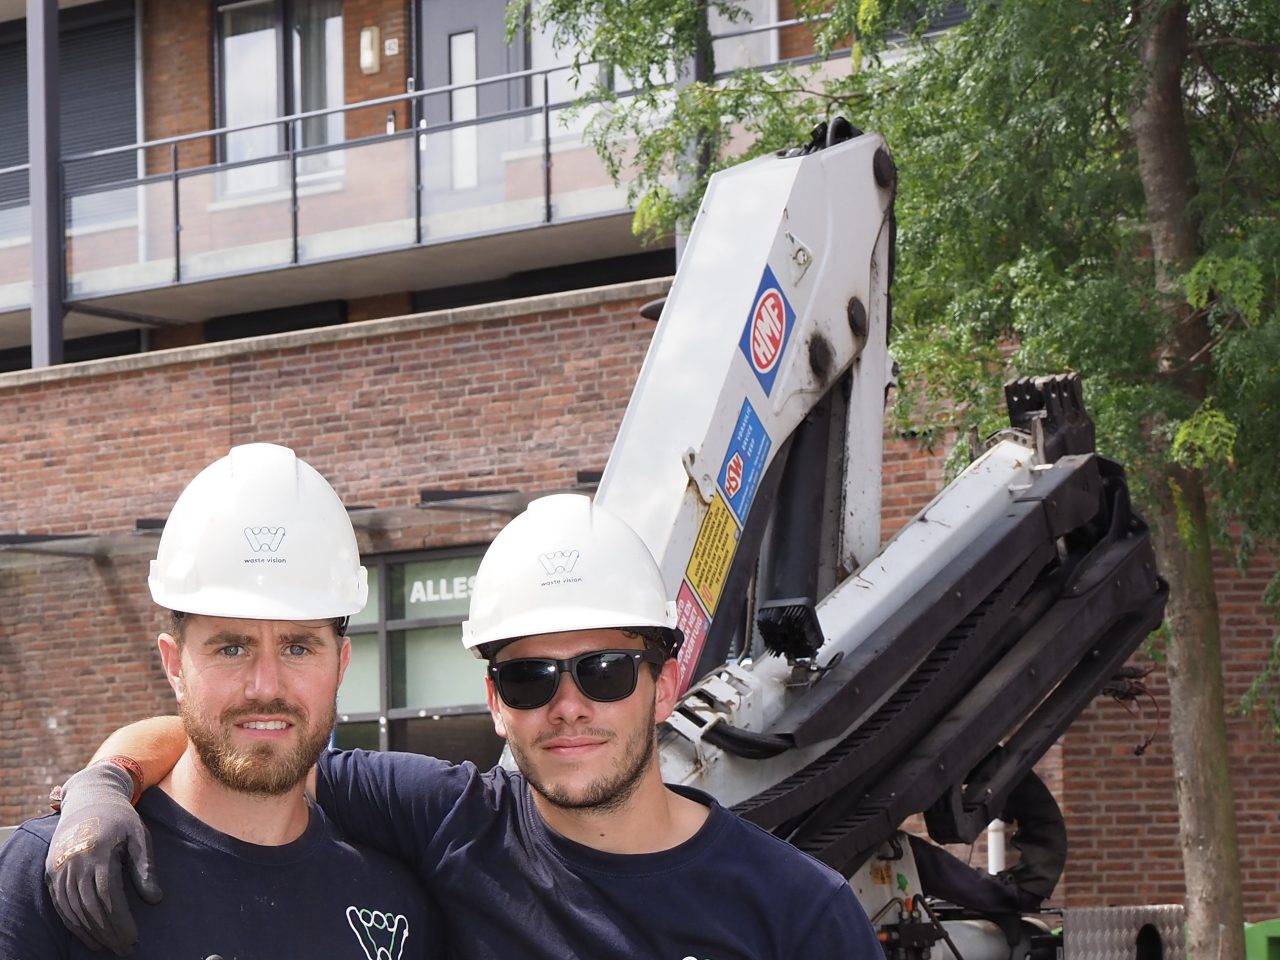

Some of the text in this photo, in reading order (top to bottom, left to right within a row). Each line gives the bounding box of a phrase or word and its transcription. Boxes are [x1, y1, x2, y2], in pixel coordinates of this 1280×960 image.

[753, 297, 782, 365] HMF
[725, 454, 742, 497] HSW
[688, 606, 697, 628] HET
[684, 616, 703, 664] VOERTUIG
